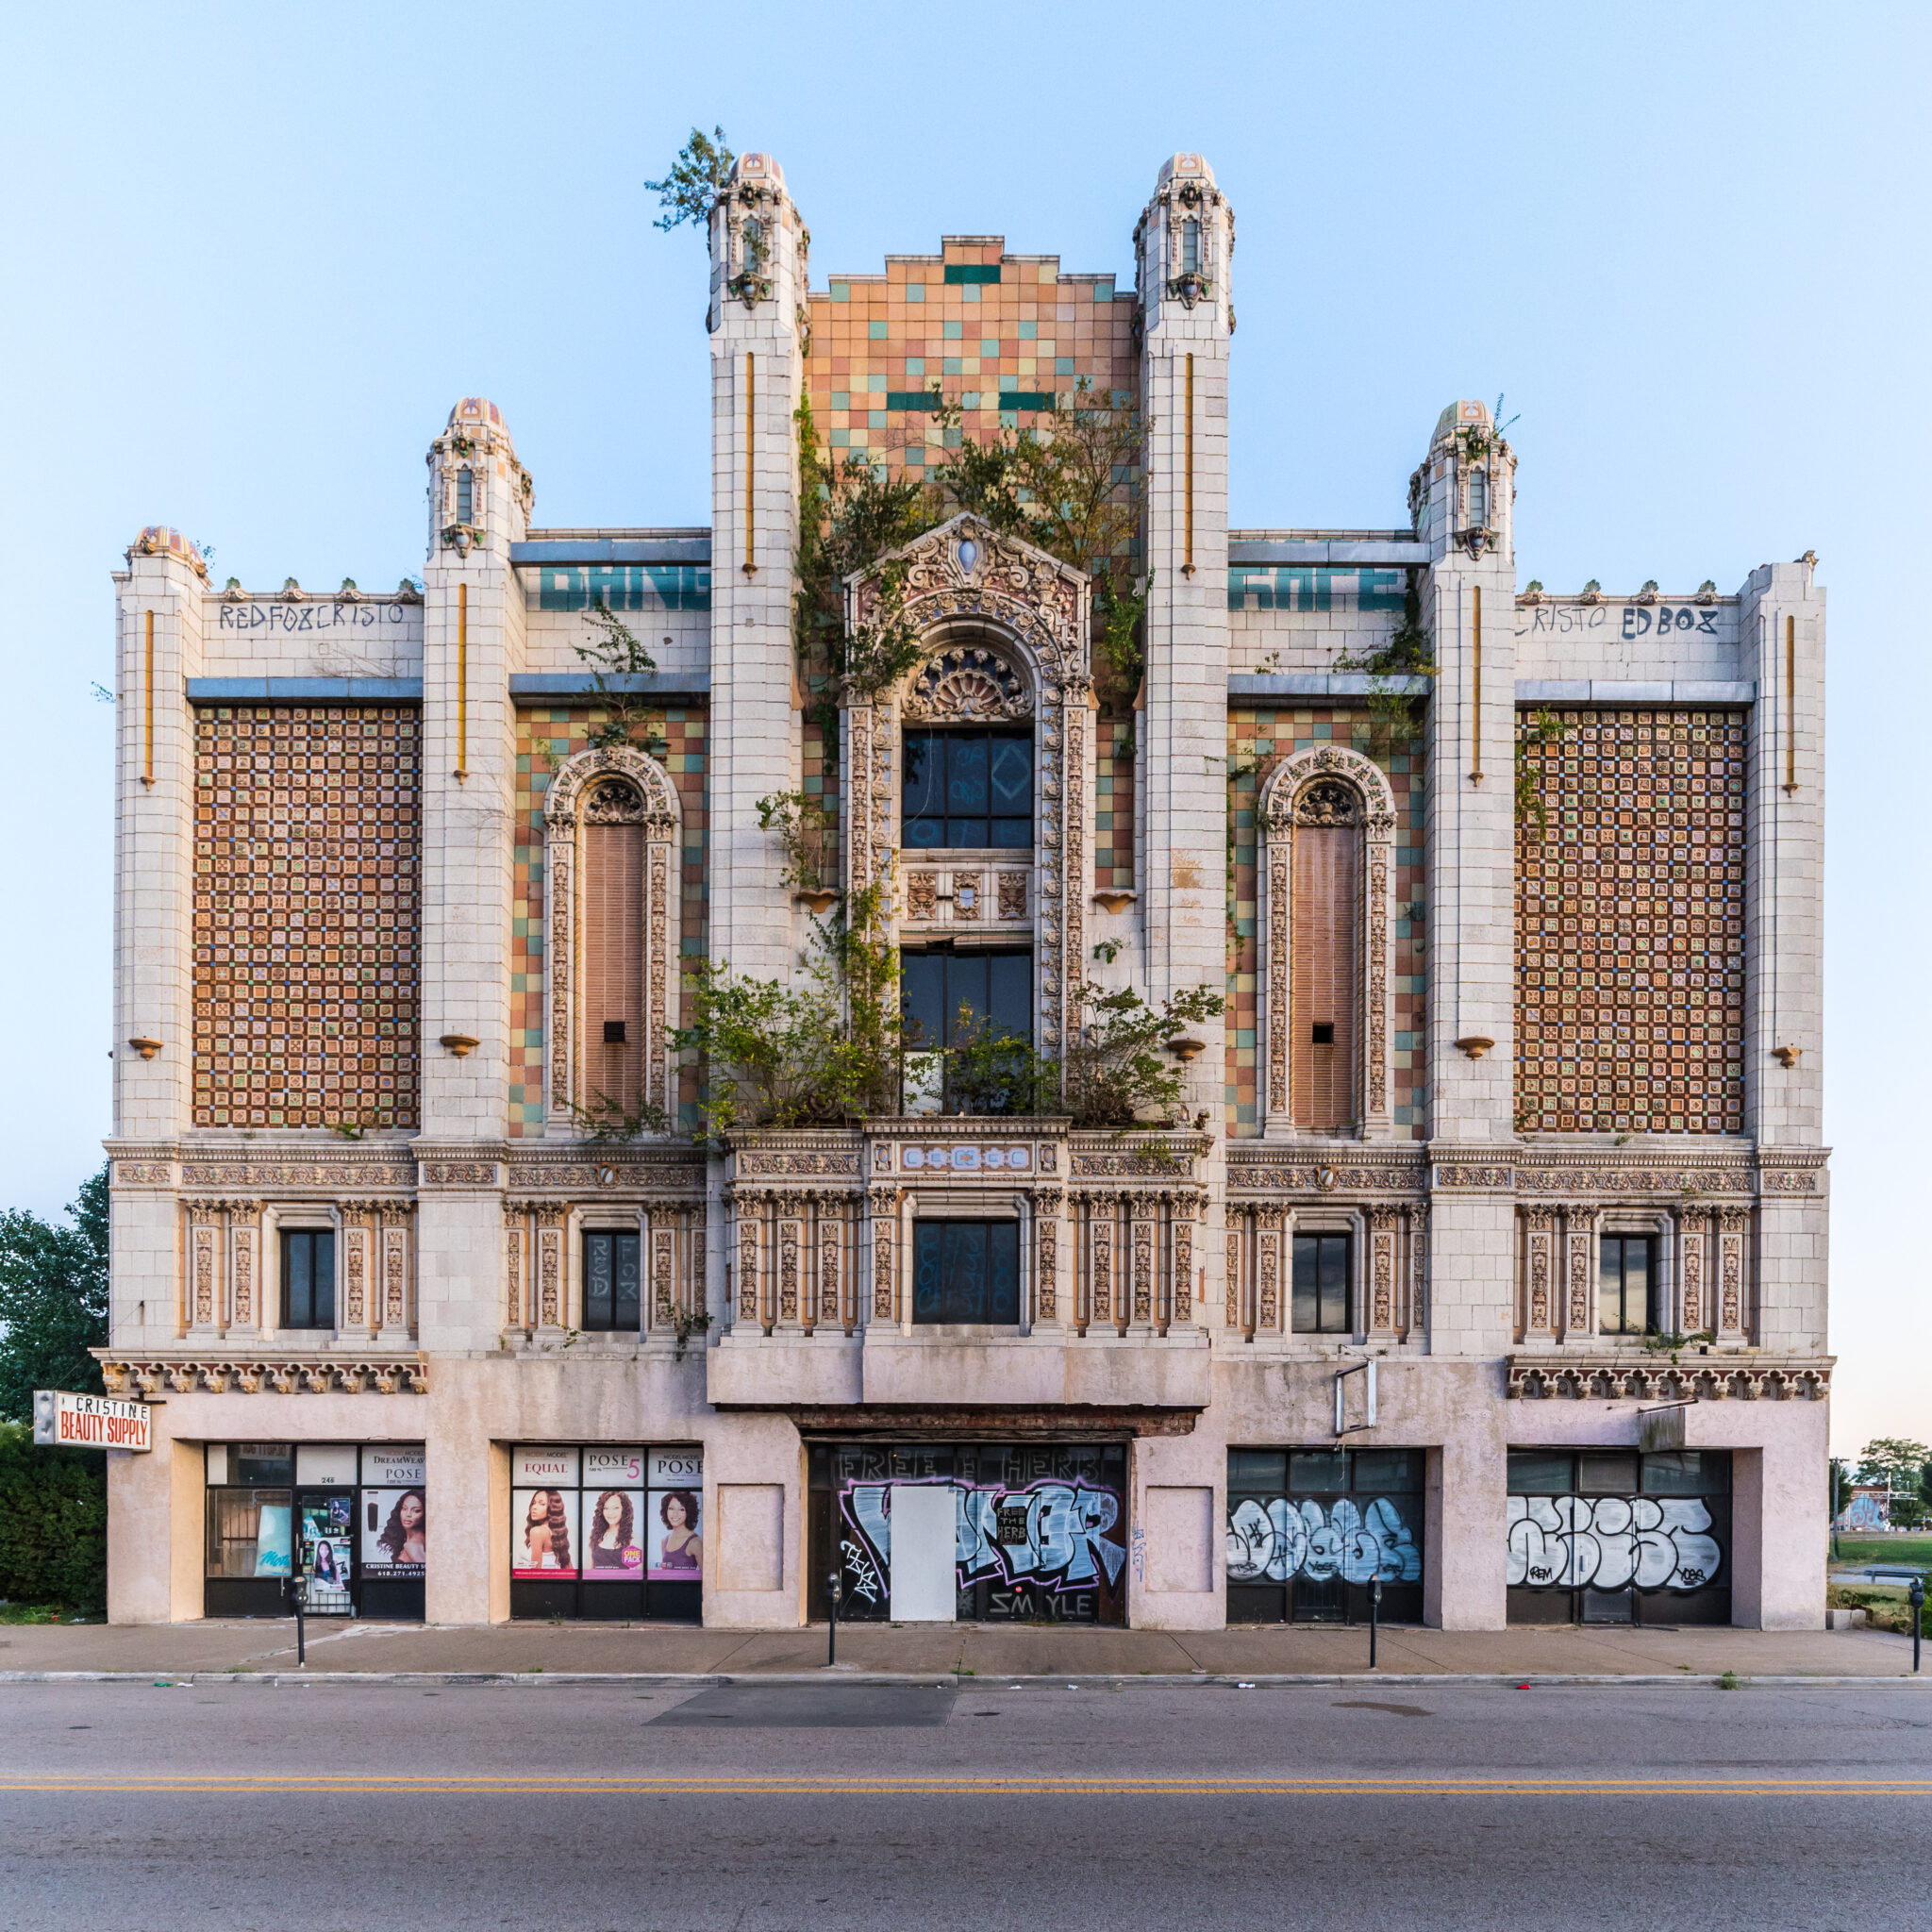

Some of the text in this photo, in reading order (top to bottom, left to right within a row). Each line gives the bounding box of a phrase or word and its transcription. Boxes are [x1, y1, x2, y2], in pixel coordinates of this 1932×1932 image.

[75, 1396, 148, 1420] CRISTINE
[60, 1410, 148, 1445] BEAUTY SUPPLY
[386, 1468, 422, 1479] POSE
[525, 1463, 569, 1475] EQUAL
[589, 1455, 640, 1479] POSE 5
[658, 1459, 703, 1474] POSE
[996, 1507, 1025, 1517] FREE
[997, 1526, 1026, 1539] HERB
